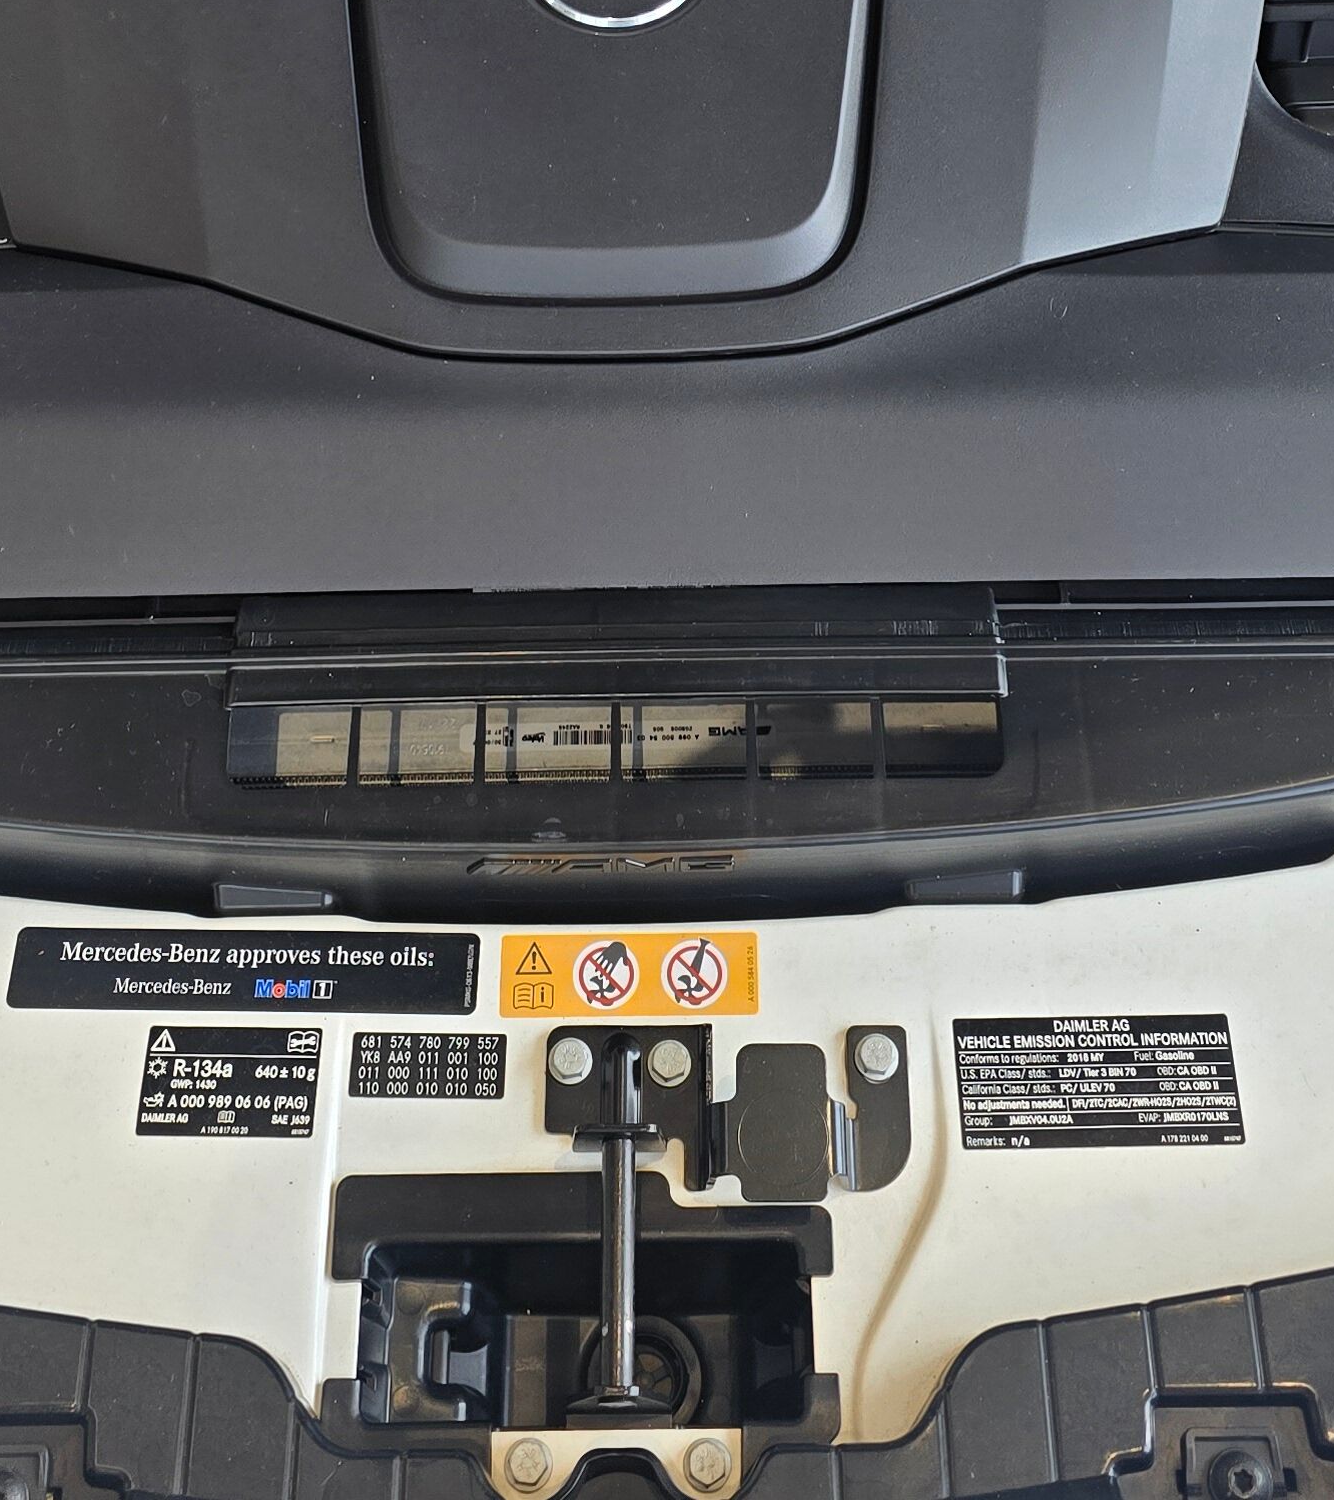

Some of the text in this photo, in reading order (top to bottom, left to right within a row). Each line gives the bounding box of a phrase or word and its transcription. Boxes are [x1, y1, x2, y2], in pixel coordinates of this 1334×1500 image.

[59, 940, 435, 969] Mercedes-Benz approves these oils:
[113, 977, 231, 996] Mercedes-Benz
[253, 978, 311, 999] Mobil
[1053, 1019, 1130, 1032] DAIMLER AG
[361, 1035, 499, 1050] 681 574 780 799 557
[957, 1032, 1228, 1049] VEHICLE EMISSION CONTROL INFORMATION
[360, 1051, 499, 1065] YK8 AA9 011 001 100
[959, 1051, 1195, 1065] Conforms to regulations: 2018 MY Fuel: Gasoline
[172, 1059, 233, 1078] R-134a
[254, 1065, 278, 1079] 640
[292, 1066, 306, 1079] 10
[306, 1067, 316, 1082] g
[358, 1066, 498, 1081] 011 000 111 010 100
[960, 1069, 978, 1079] U.S.
[980, 1069, 997, 1079] EPA
[1108, 1067, 1124, 1077] BIN
[1125, 1067, 1137, 1077] 70
[1157, 1066, 1177, 1076] OBD:
[1177, 1066, 1190, 1075] CA
[1191, 1066, 1210, 1075] OBD
[170, 1079, 217, 1090] GWP: 1430
[358, 1082, 497, 1096] 110 000 010 010 050
[962, 1084, 1001, 1095] California
[1079, 1082, 1103, 1093] ULEV
[1103, 1082, 1116, 1092] 70
[1159, 1081, 1178, 1091] OBD:
[1178, 1081, 1192, 1091] CA
[1193, 1081, 1212, 1091] OBD
[167, 1094, 308, 1112] A 000 989 06 06 (PAG)
[963, 1100, 977, 1110] No
[977, 1099, 1030, 1111] adjustments
[1032, 1098, 1066, 1109] needed.
[141, 1112, 189, 1123] DAIMLER AG
[270, 1114, 310, 1125] SAE J639
[964, 1116, 993, 1127] Group:
[1138, 1113, 1161, 1123] EVAP:
[966, 1136, 1006, 1147] Remarks:
[1011, 1135, 1030, 1147] n/a
